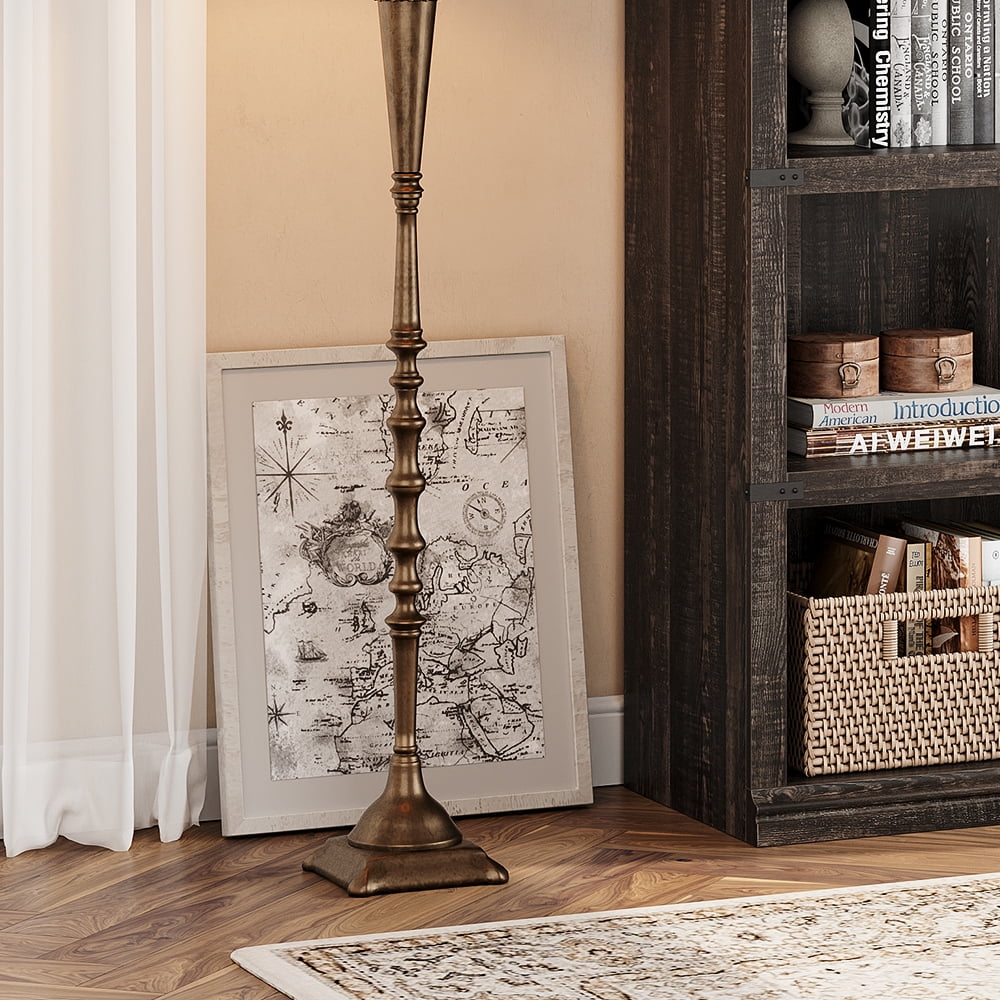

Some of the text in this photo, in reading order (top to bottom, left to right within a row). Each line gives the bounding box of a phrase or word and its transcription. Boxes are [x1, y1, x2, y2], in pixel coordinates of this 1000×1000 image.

[964, 12, 973, 79] ONTARIO
[983, 46, 991, 54] a
[931, 52, 939, 107] SCHOOL
[951, 46, 961, 104] SCHOOL
[983, 56, 992, 97] Nation
[871, 50, 891, 147] Chemistry
[819, 414, 877, 427] American
[823, 402, 869, 414] Modern
[886, 424, 996, 451] WEIWEI
